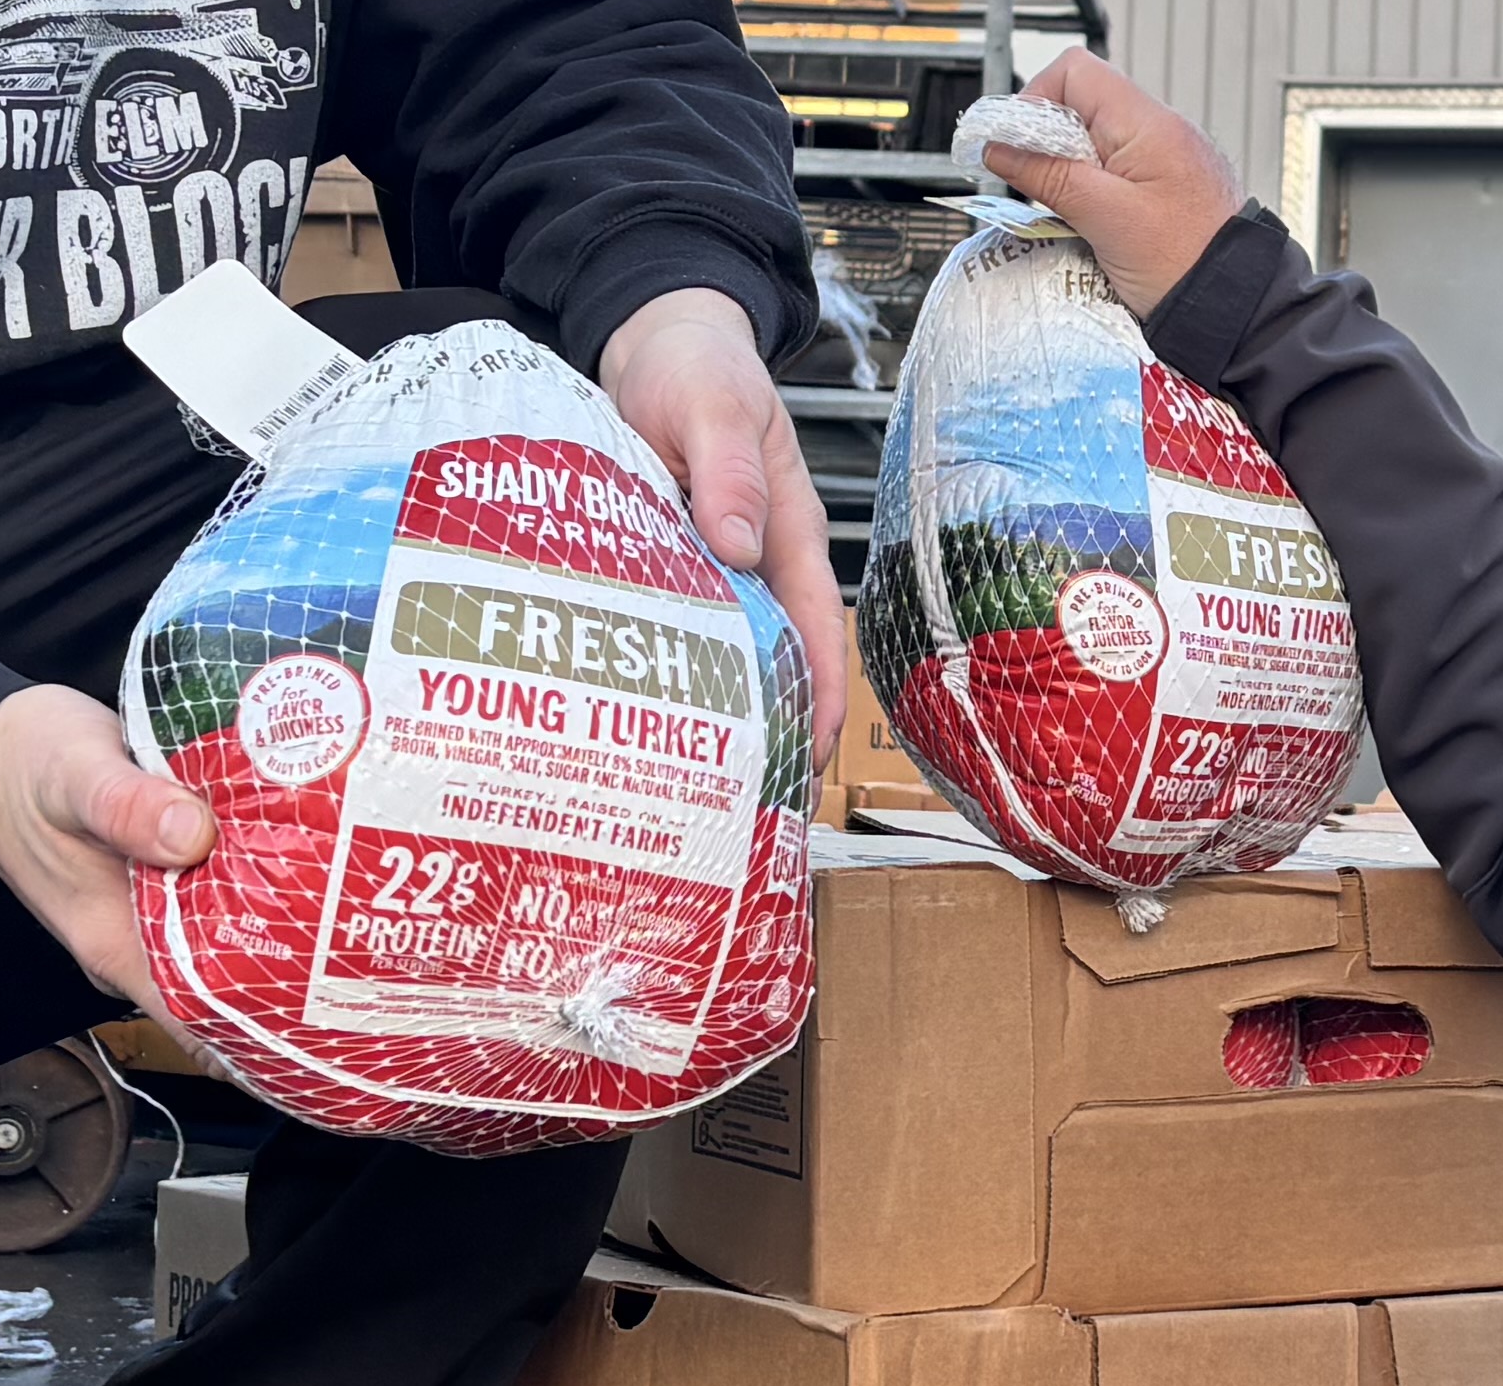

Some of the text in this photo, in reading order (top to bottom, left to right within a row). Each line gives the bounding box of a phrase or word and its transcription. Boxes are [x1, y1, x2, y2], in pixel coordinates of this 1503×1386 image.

[96, 90, 210, 164] ELM
[56, 155, 307, 332] BLOC
[1224, 439, 1275, 468] FAR
[435, 460, 699, 559] SHADY BROOK
[517, 513, 640, 560] FARMS
[1070, 581, 1144, 613] PRE-BRINED
[1097, 600, 1119, 613] for
[1197, 592, 1280, 638] YOUNG
[1080, 630, 1153, 648] & JUICINESS
[1088, 614, 1136, 631] FLAVOR
[480, 600, 690, 692] FRESH
[251, 666, 341, 704] PRE-BRINED
[1121, 664, 1132, 675] TO
[267, 698, 323, 723] FLAVOR
[280, 686, 308, 701] for
[1216, 690, 1291, 713] INDEPENDENT
[255, 714, 344, 747] & JUICINESS
[418, 668, 732, 767] YOUNG TURKEY
[297, 761, 312, 775] TO
[314, 739, 343, 768] COOK
[384, 716, 464, 743] PRE-BRINED
[469, 726, 502, 749] WITH
[504, 736, 610, 767] APPROXIMATELY
[392, 736, 439, 760] BROTH,
[445, 745, 505, 771] VINEGAR,
[509, 755, 543, 777] SALT,
[545, 761, 590, 784] SUGAR
[1169, 729, 1235, 775] 22g
[1239, 746, 1268, 775] NO
[441, 793, 684, 858] INDEPENDENT FARMS
[565, 798, 631, 820] RAISED
[638, 811, 663, 826] ON
[371, 845, 484, 916] 22g
[511, 884, 571, 929] NO
[345, 912, 484, 959] PROTEIN
[499, 939, 555, 980] NO
[168, 1271, 217, 1328] PRO
